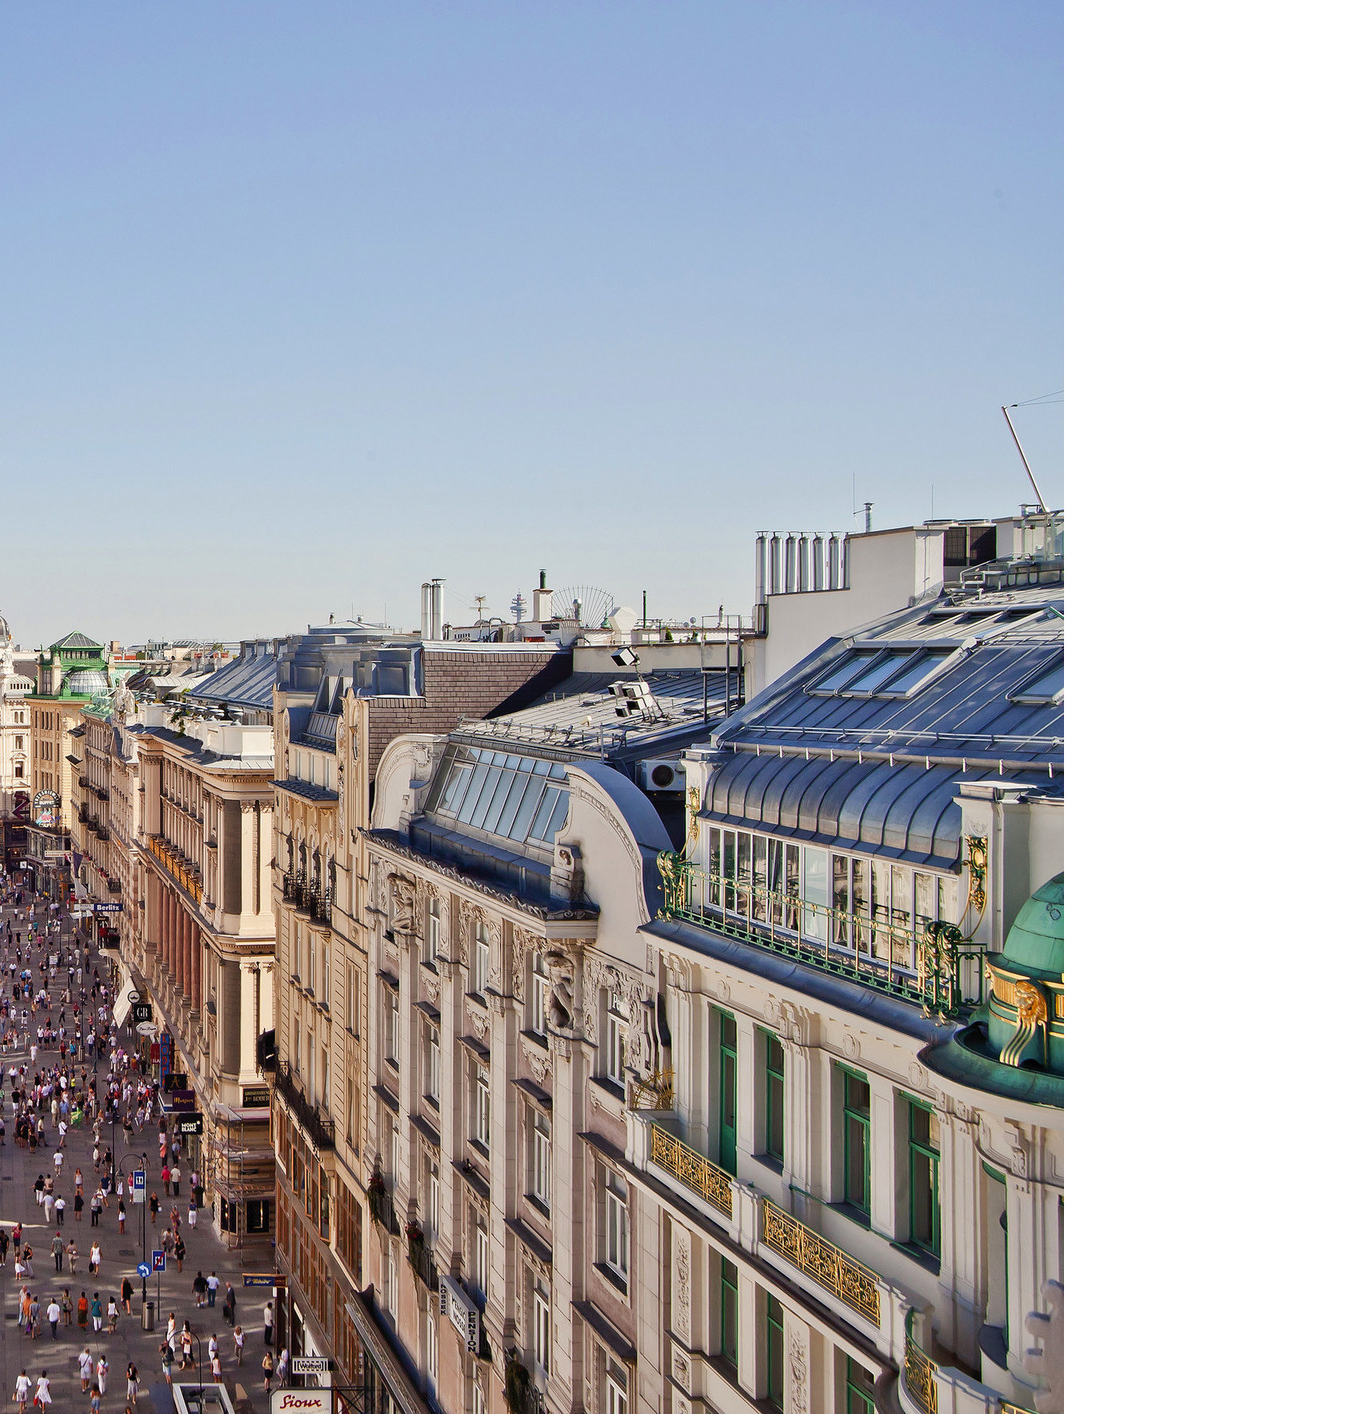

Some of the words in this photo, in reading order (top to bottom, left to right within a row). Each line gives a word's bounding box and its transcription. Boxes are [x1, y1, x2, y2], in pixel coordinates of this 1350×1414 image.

[136, 1007, 148, 1018] GR
[467, 1311, 477, 1353] PENSION
[299, 1362, 322, 1370] Wolford
[279, 1394, 323, 1410] Sioux
